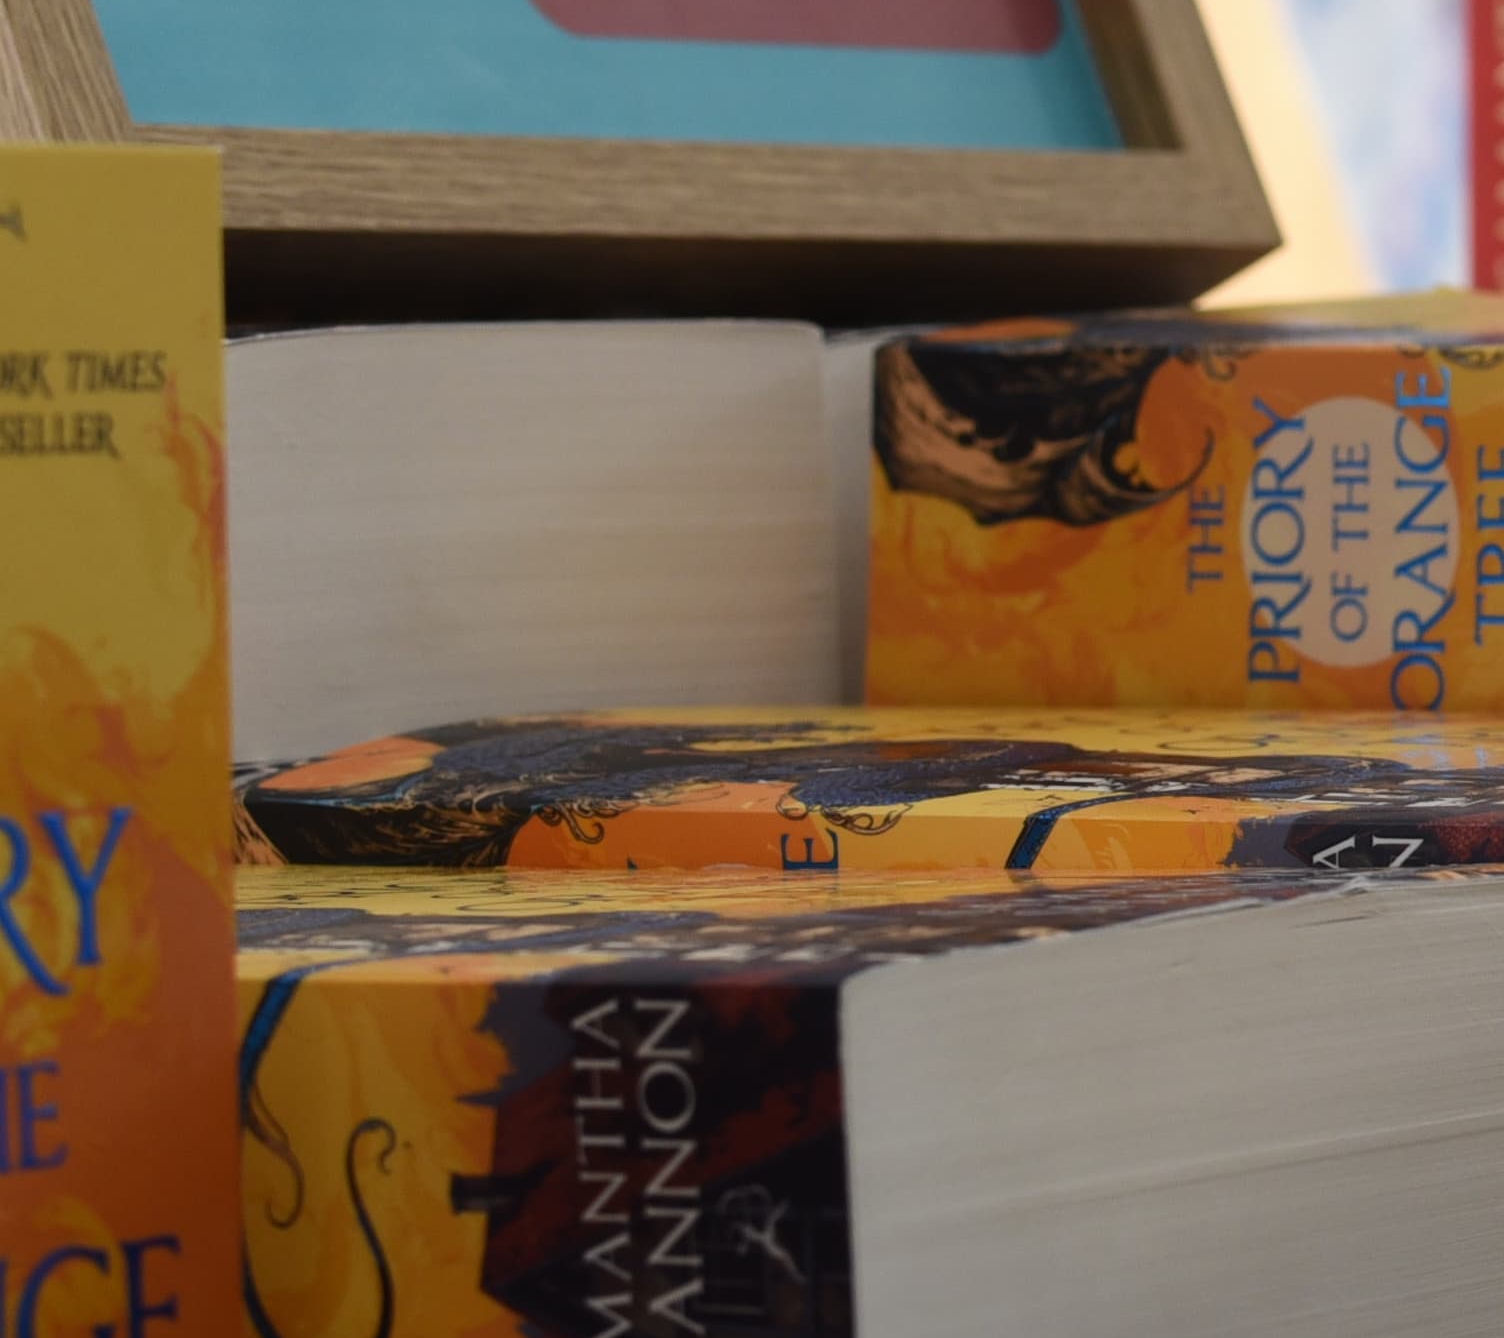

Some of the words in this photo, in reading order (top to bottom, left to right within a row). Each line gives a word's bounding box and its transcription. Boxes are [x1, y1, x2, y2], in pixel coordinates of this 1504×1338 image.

[64, 348, 167, 394] TIMES
[1188, 483, 1225, 594] THE
[1248, 396, 1314, 684] PRIORY
[1331, 441, 1371, 551] THE
[1390, 365, 1456, 711] ORANGE
[1330, 572, 1368, 643] OF
